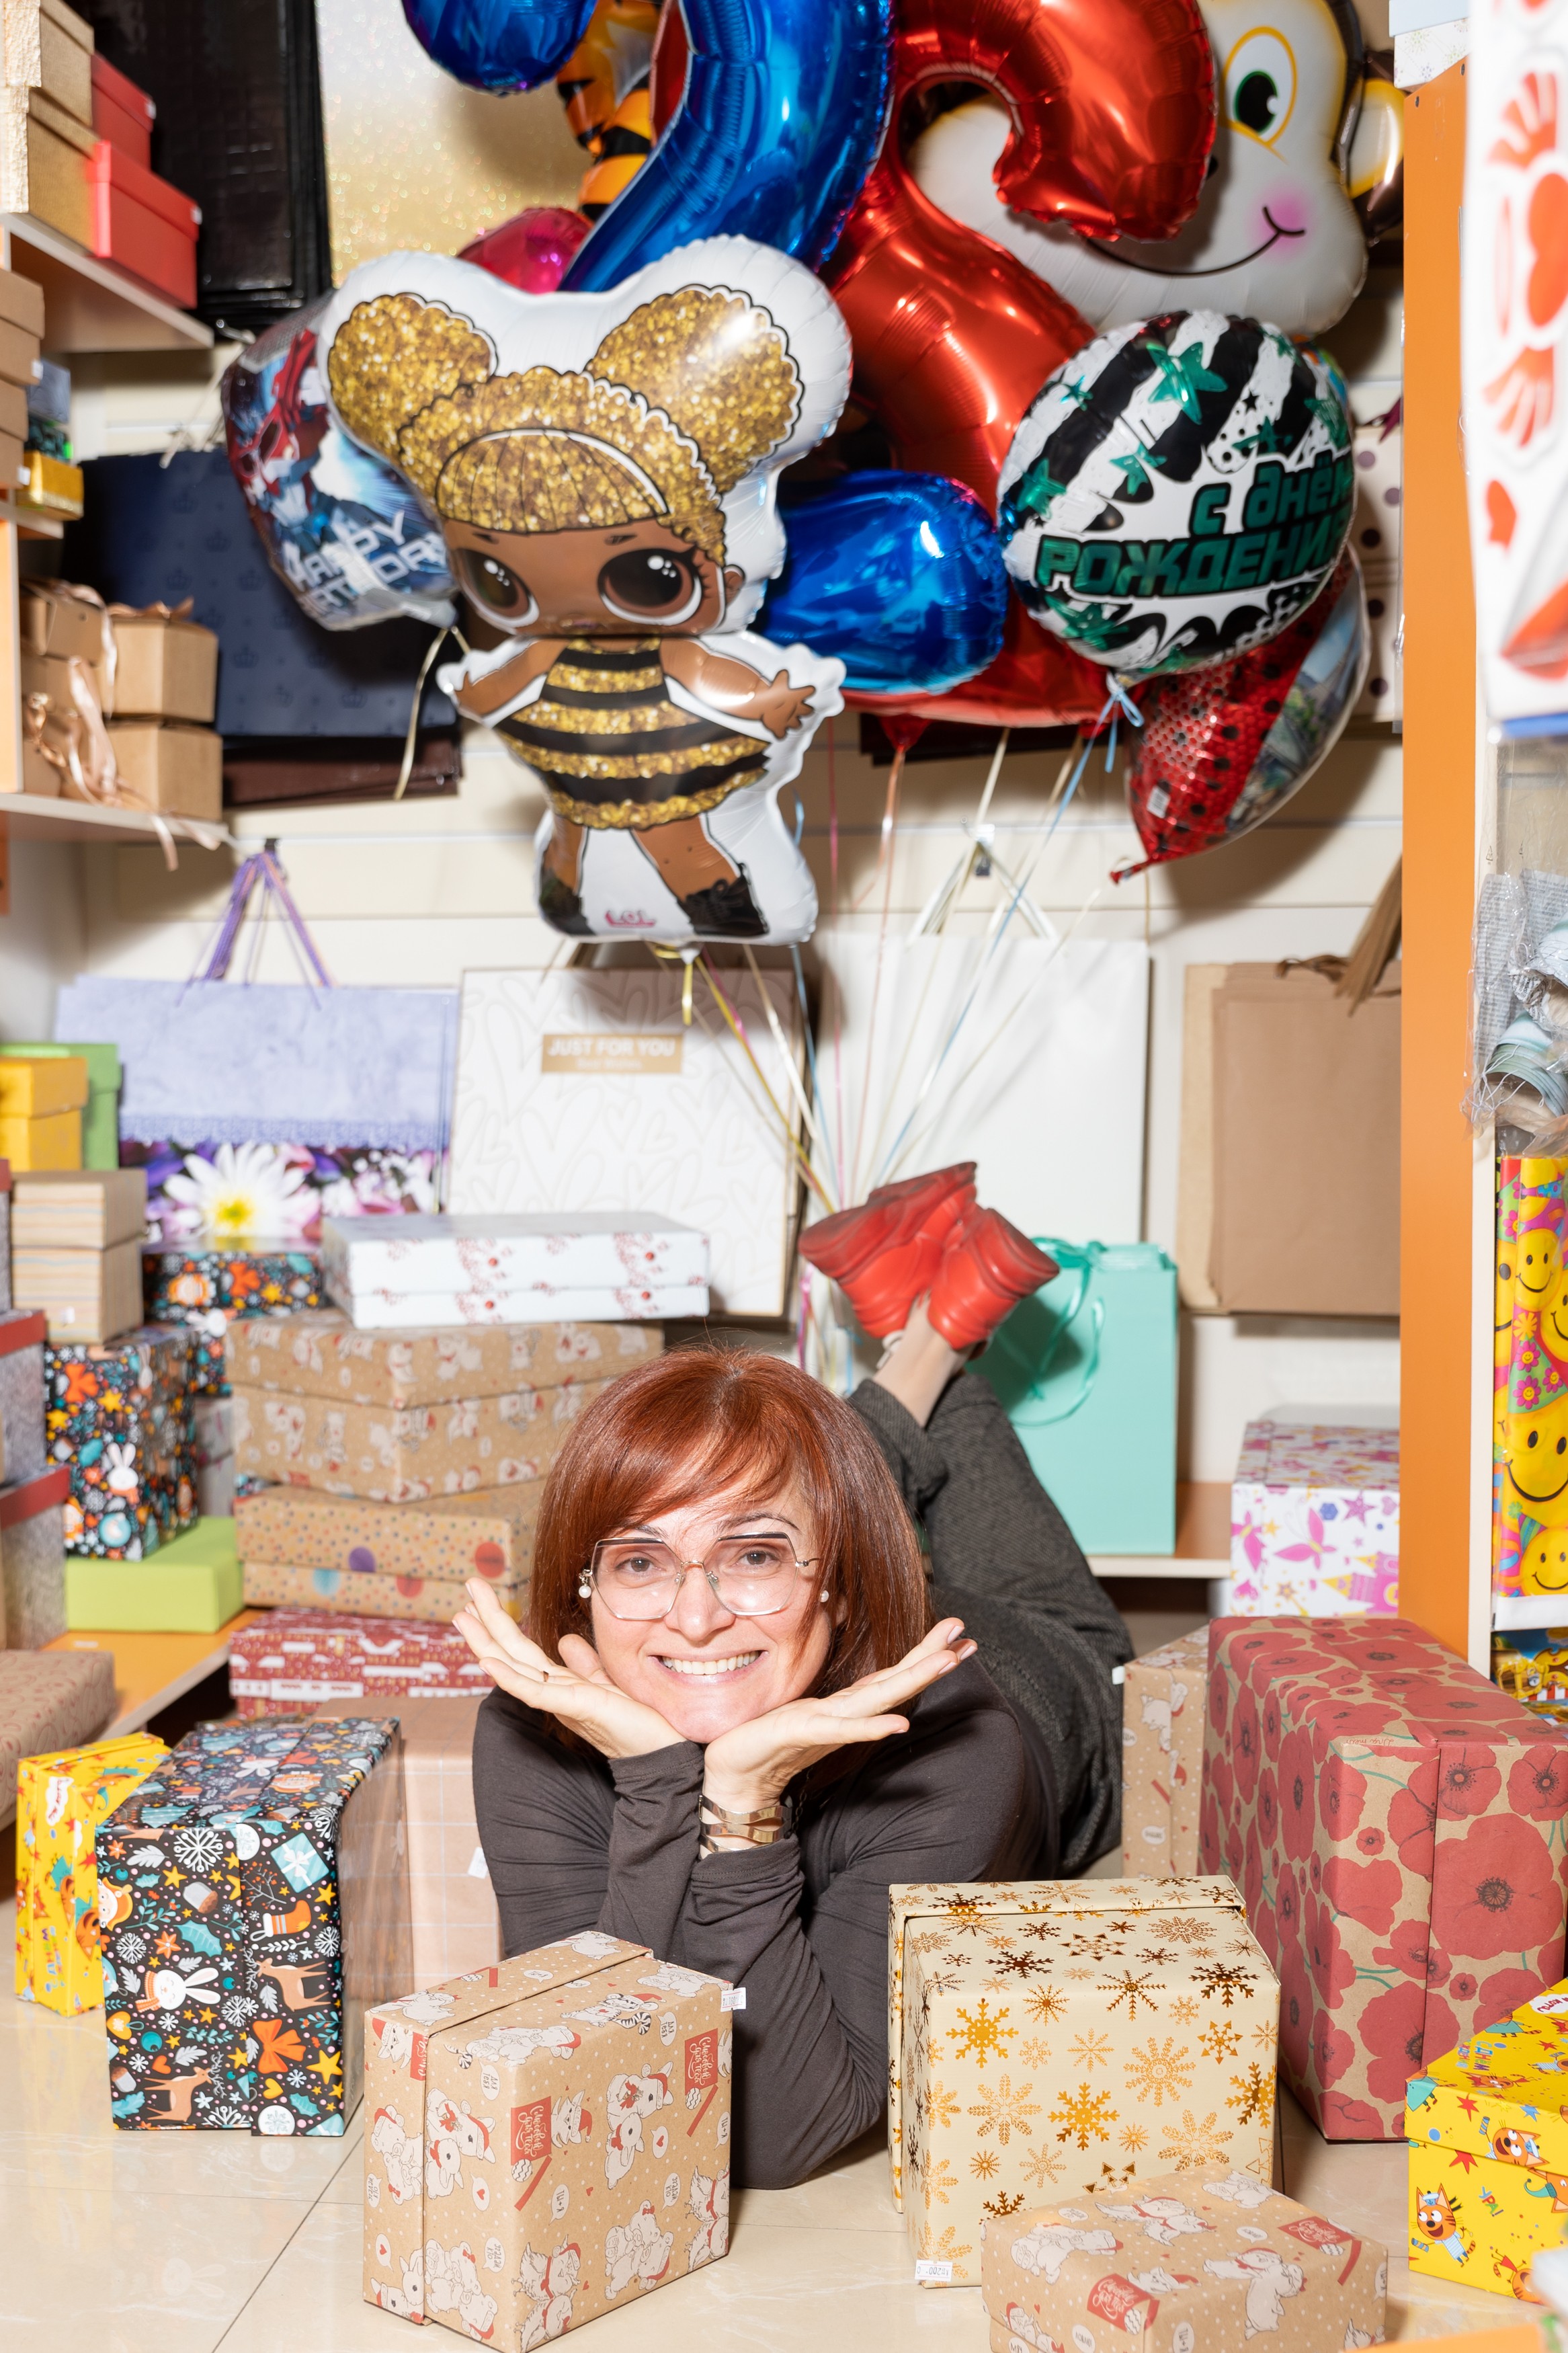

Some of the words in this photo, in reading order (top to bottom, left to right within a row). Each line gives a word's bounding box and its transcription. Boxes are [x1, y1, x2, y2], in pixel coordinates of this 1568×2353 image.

[281, 510, 405, 592] HAPY
[549, 1038, 592, 1056] JUST
[595, 1037, 635, 1057] FOR
[639, 1037, 676, 1058] YOU
[1478, 2186, 1504, 2217] УРА!
